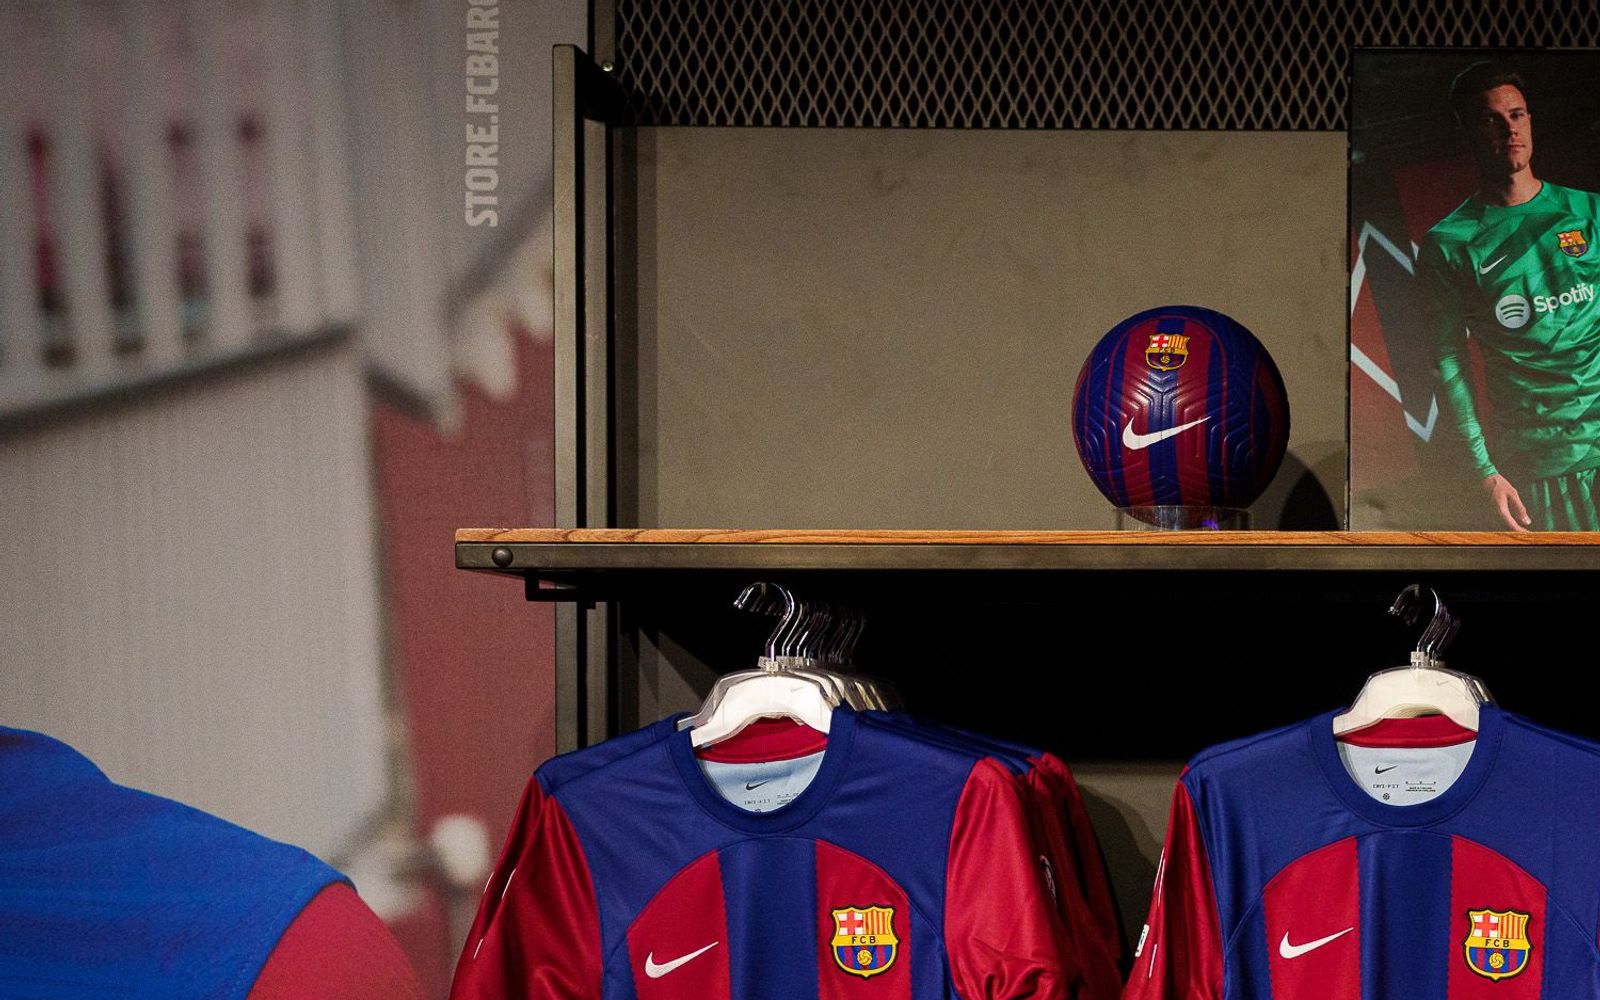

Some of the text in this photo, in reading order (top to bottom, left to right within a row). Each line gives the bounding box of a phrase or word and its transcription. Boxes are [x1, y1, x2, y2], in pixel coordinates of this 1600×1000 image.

[465, 0, 499, 227] STORE.FCBAR
[1533, 283, 1593, 313] Spotify
[851, 935, 876, 944] FCB
[1485, 938, 1510, 948] FCB
